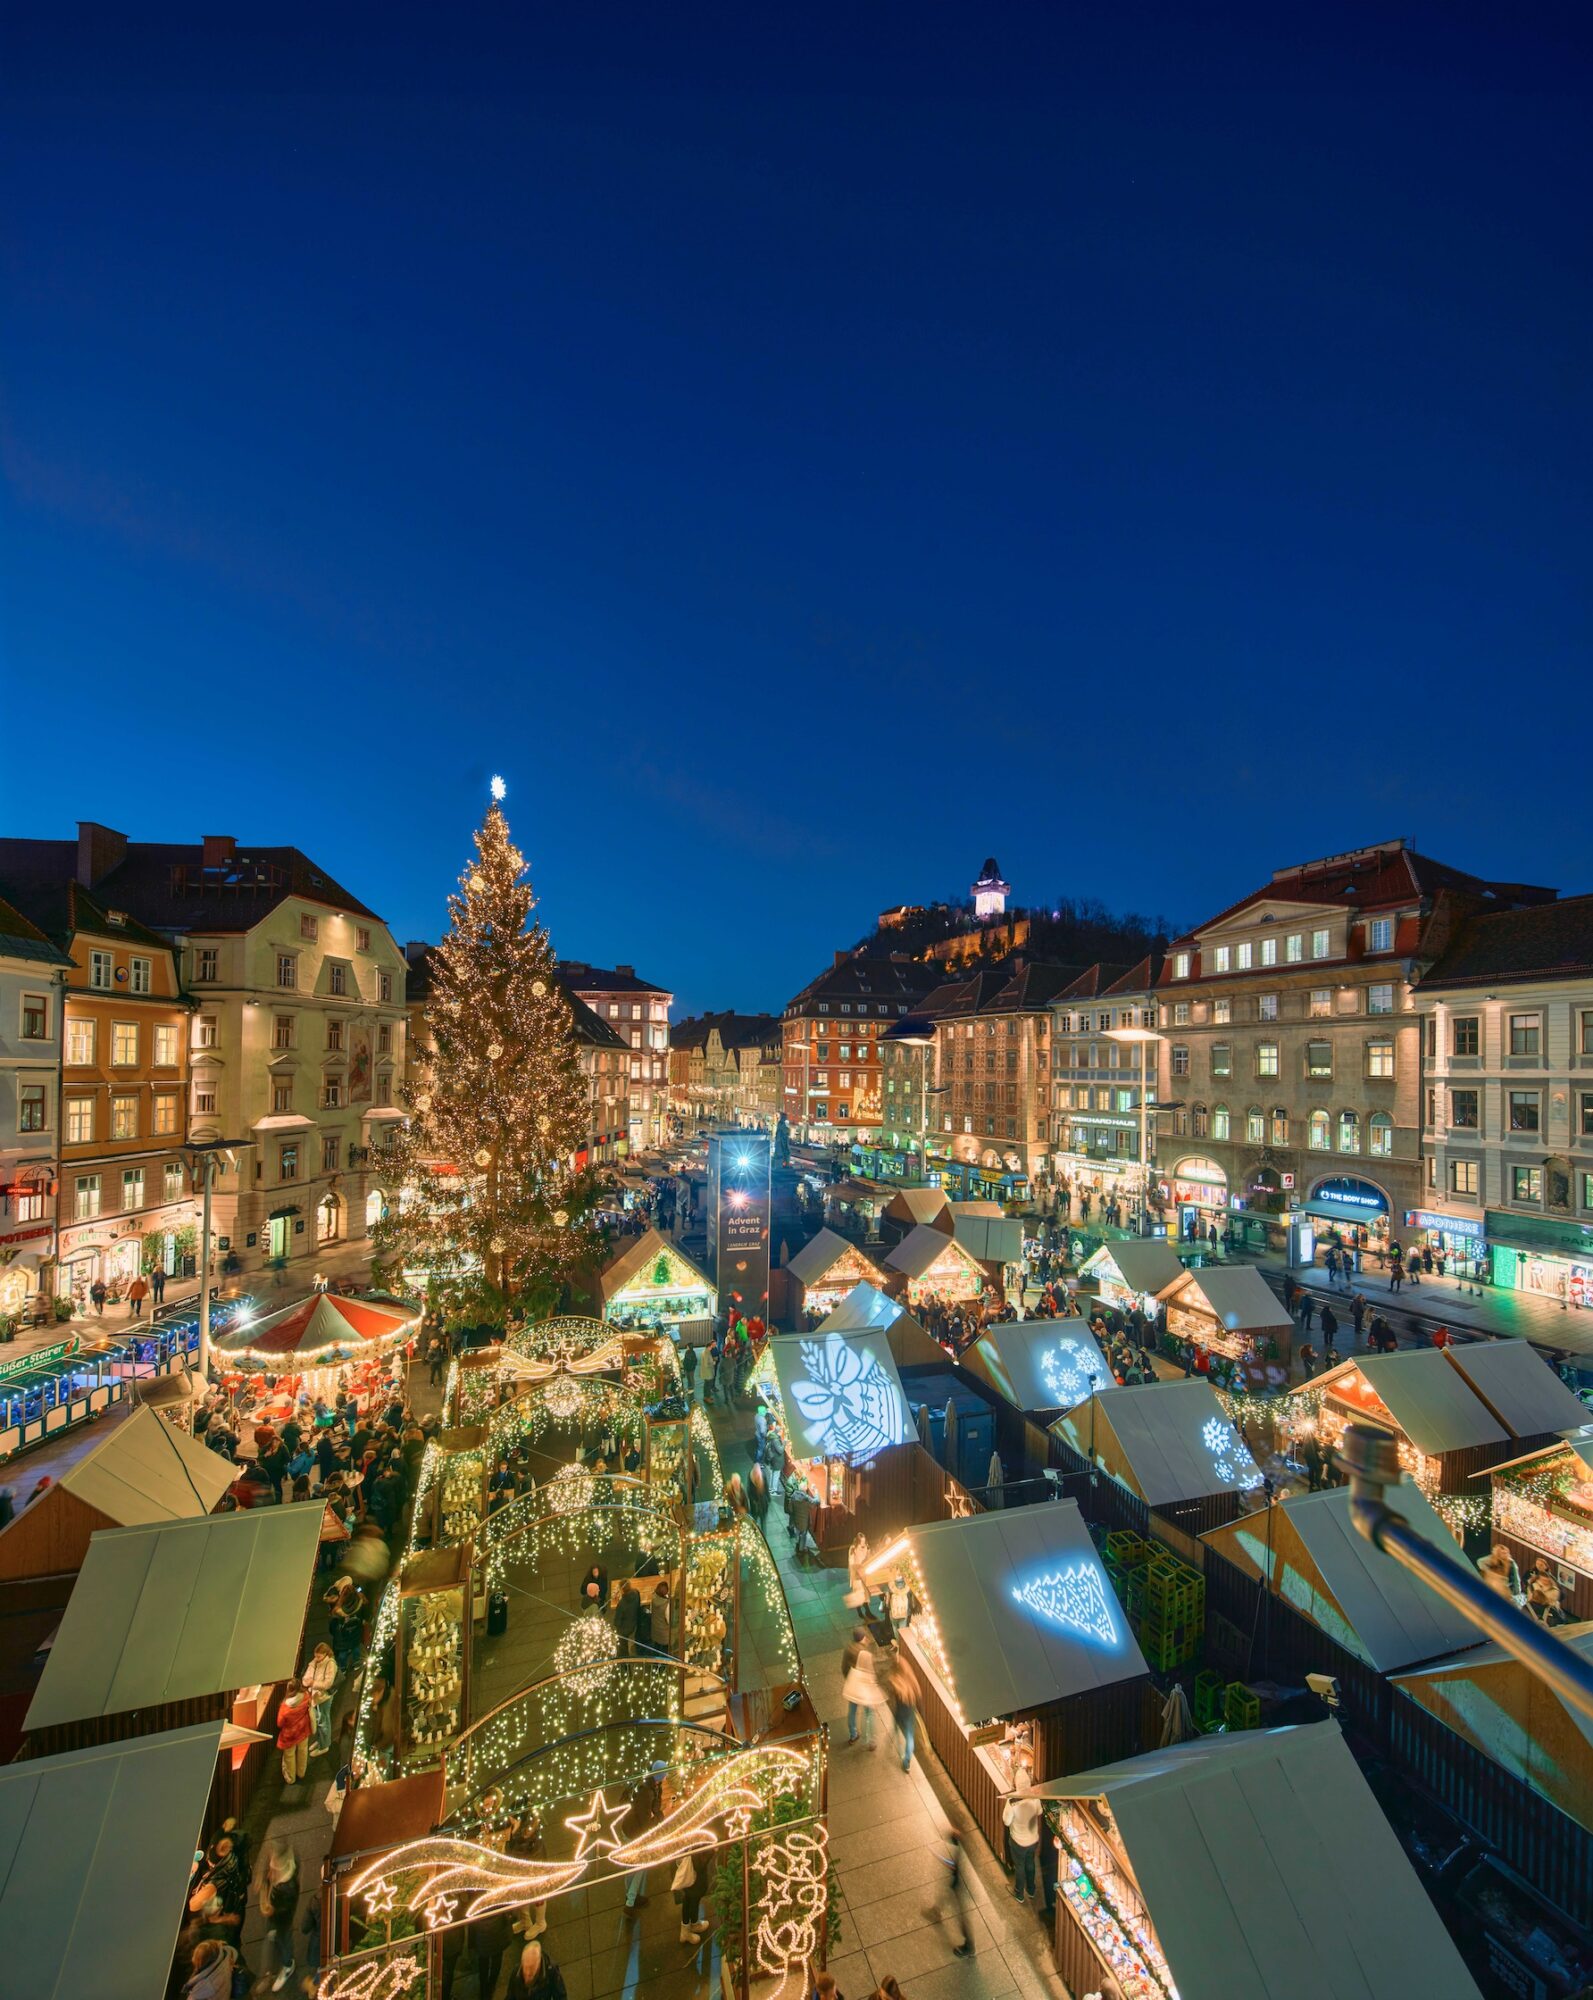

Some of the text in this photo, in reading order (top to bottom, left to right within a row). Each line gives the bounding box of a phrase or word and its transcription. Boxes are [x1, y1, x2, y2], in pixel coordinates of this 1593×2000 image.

[1070, 1116, 1136, 1127] WEIKHARD HAUS
[1106, 1157, 1152, 1168] UHRENHAS
[1330, 1193, 1380, 1206] THE BODY SHOP
[728, 1216, 761, 1225] Advent
[1419, 1214, 1480, 1235] APOTHEKE
[728, 1226, 760, 1234] in Graz
[29, 1345, 64, 1363] Steirer
